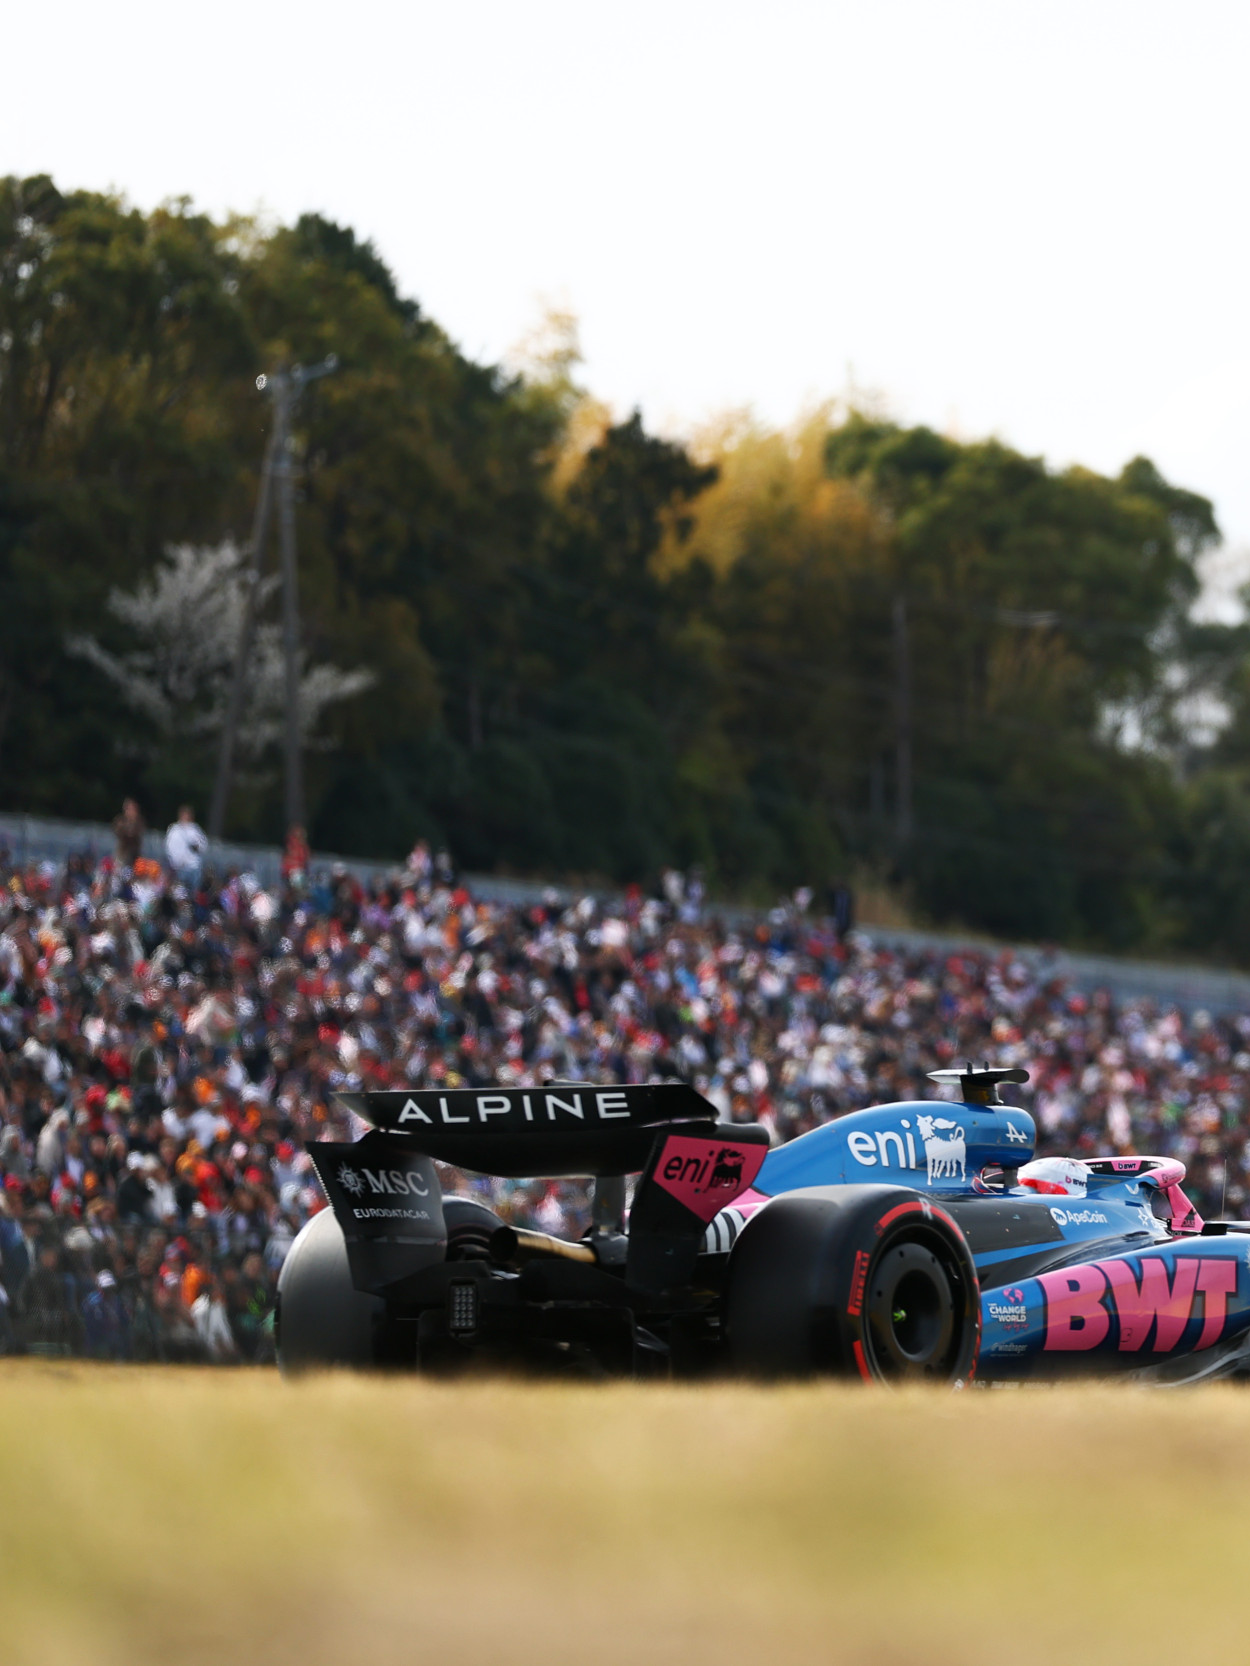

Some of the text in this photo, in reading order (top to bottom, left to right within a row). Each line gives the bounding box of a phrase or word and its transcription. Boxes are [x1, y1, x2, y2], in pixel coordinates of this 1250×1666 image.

[398, 1092, 631, 1124] ALPINE
[847, 1119, 916, 1169] eni
[663, 1150, 715, 1183] eni
[361, 1168, 429, 1196] MSC
[353, 1208, 431, 1220] EURODATACAR
[1067, 1209, 1109, 1226] ApeCoin
[989, 1305, 1027, 1315] CHANGE
[998, 1314, 1027, 1323] WORLD
[1037, 1257, 1237, 1352] BWT
